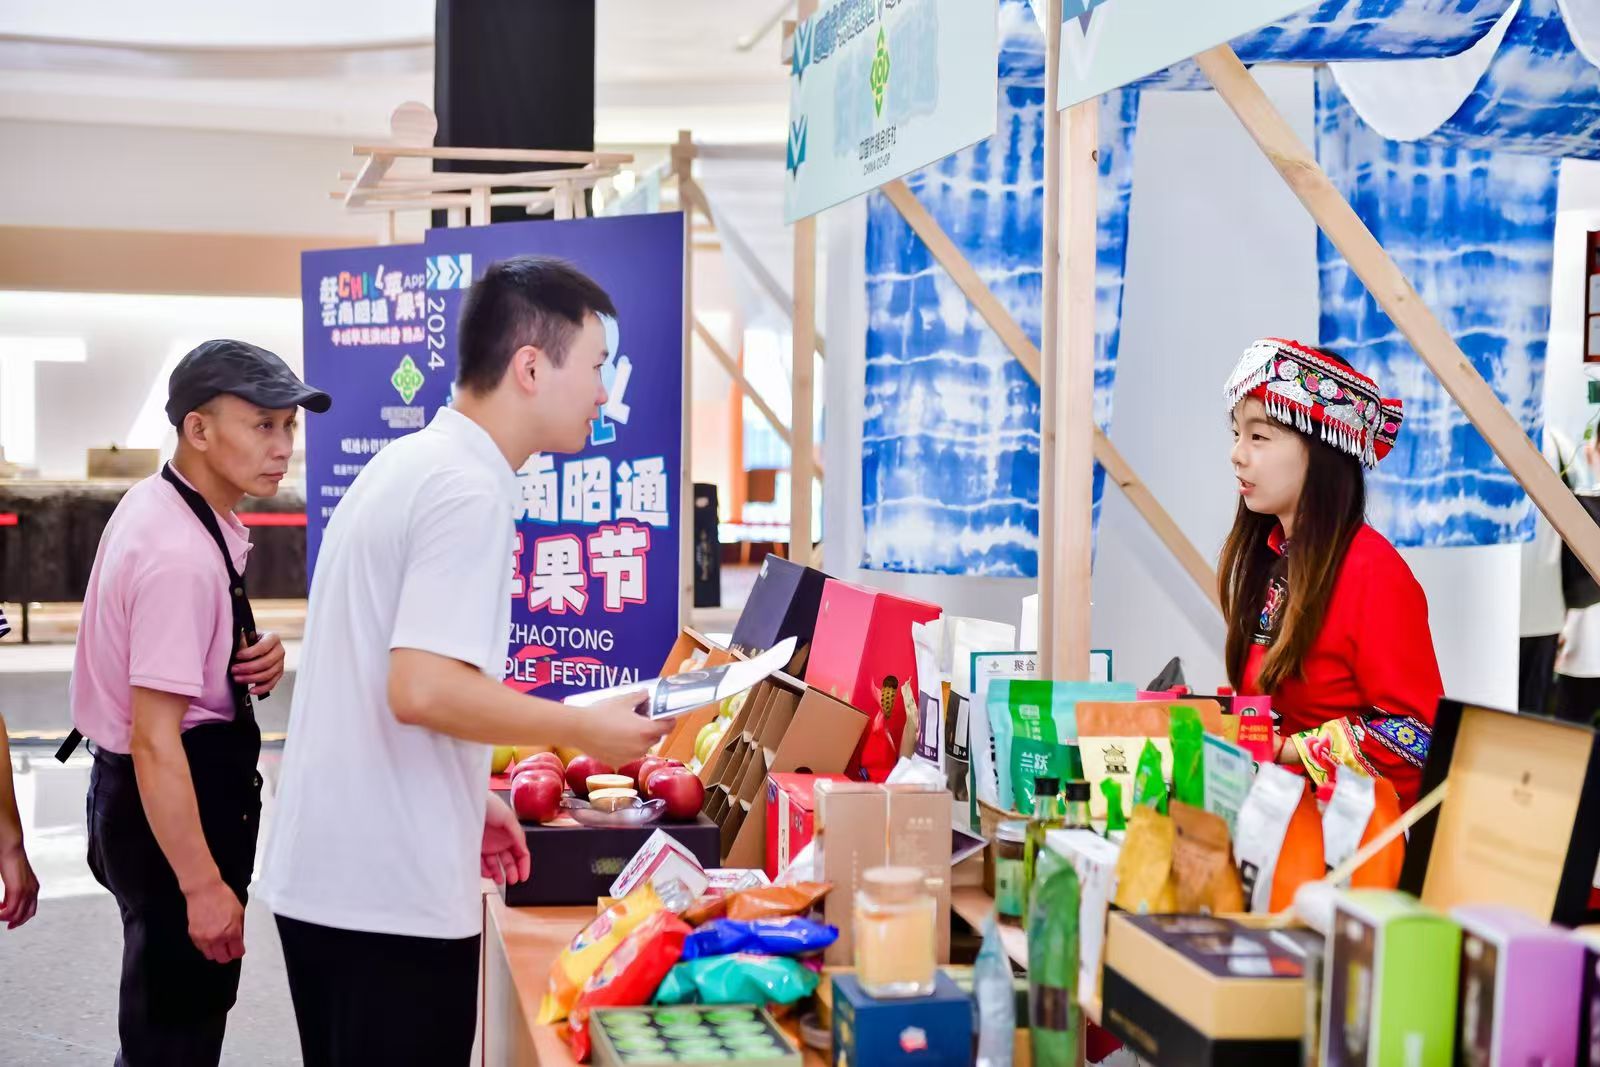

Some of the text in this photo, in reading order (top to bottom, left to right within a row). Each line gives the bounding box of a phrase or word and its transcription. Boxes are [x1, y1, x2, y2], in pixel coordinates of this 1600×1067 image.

[427, 297, 446, 371] 2024
[511, 522, 650, 615] 果节
[508, 622, 614, 651] ZHAOTONG
